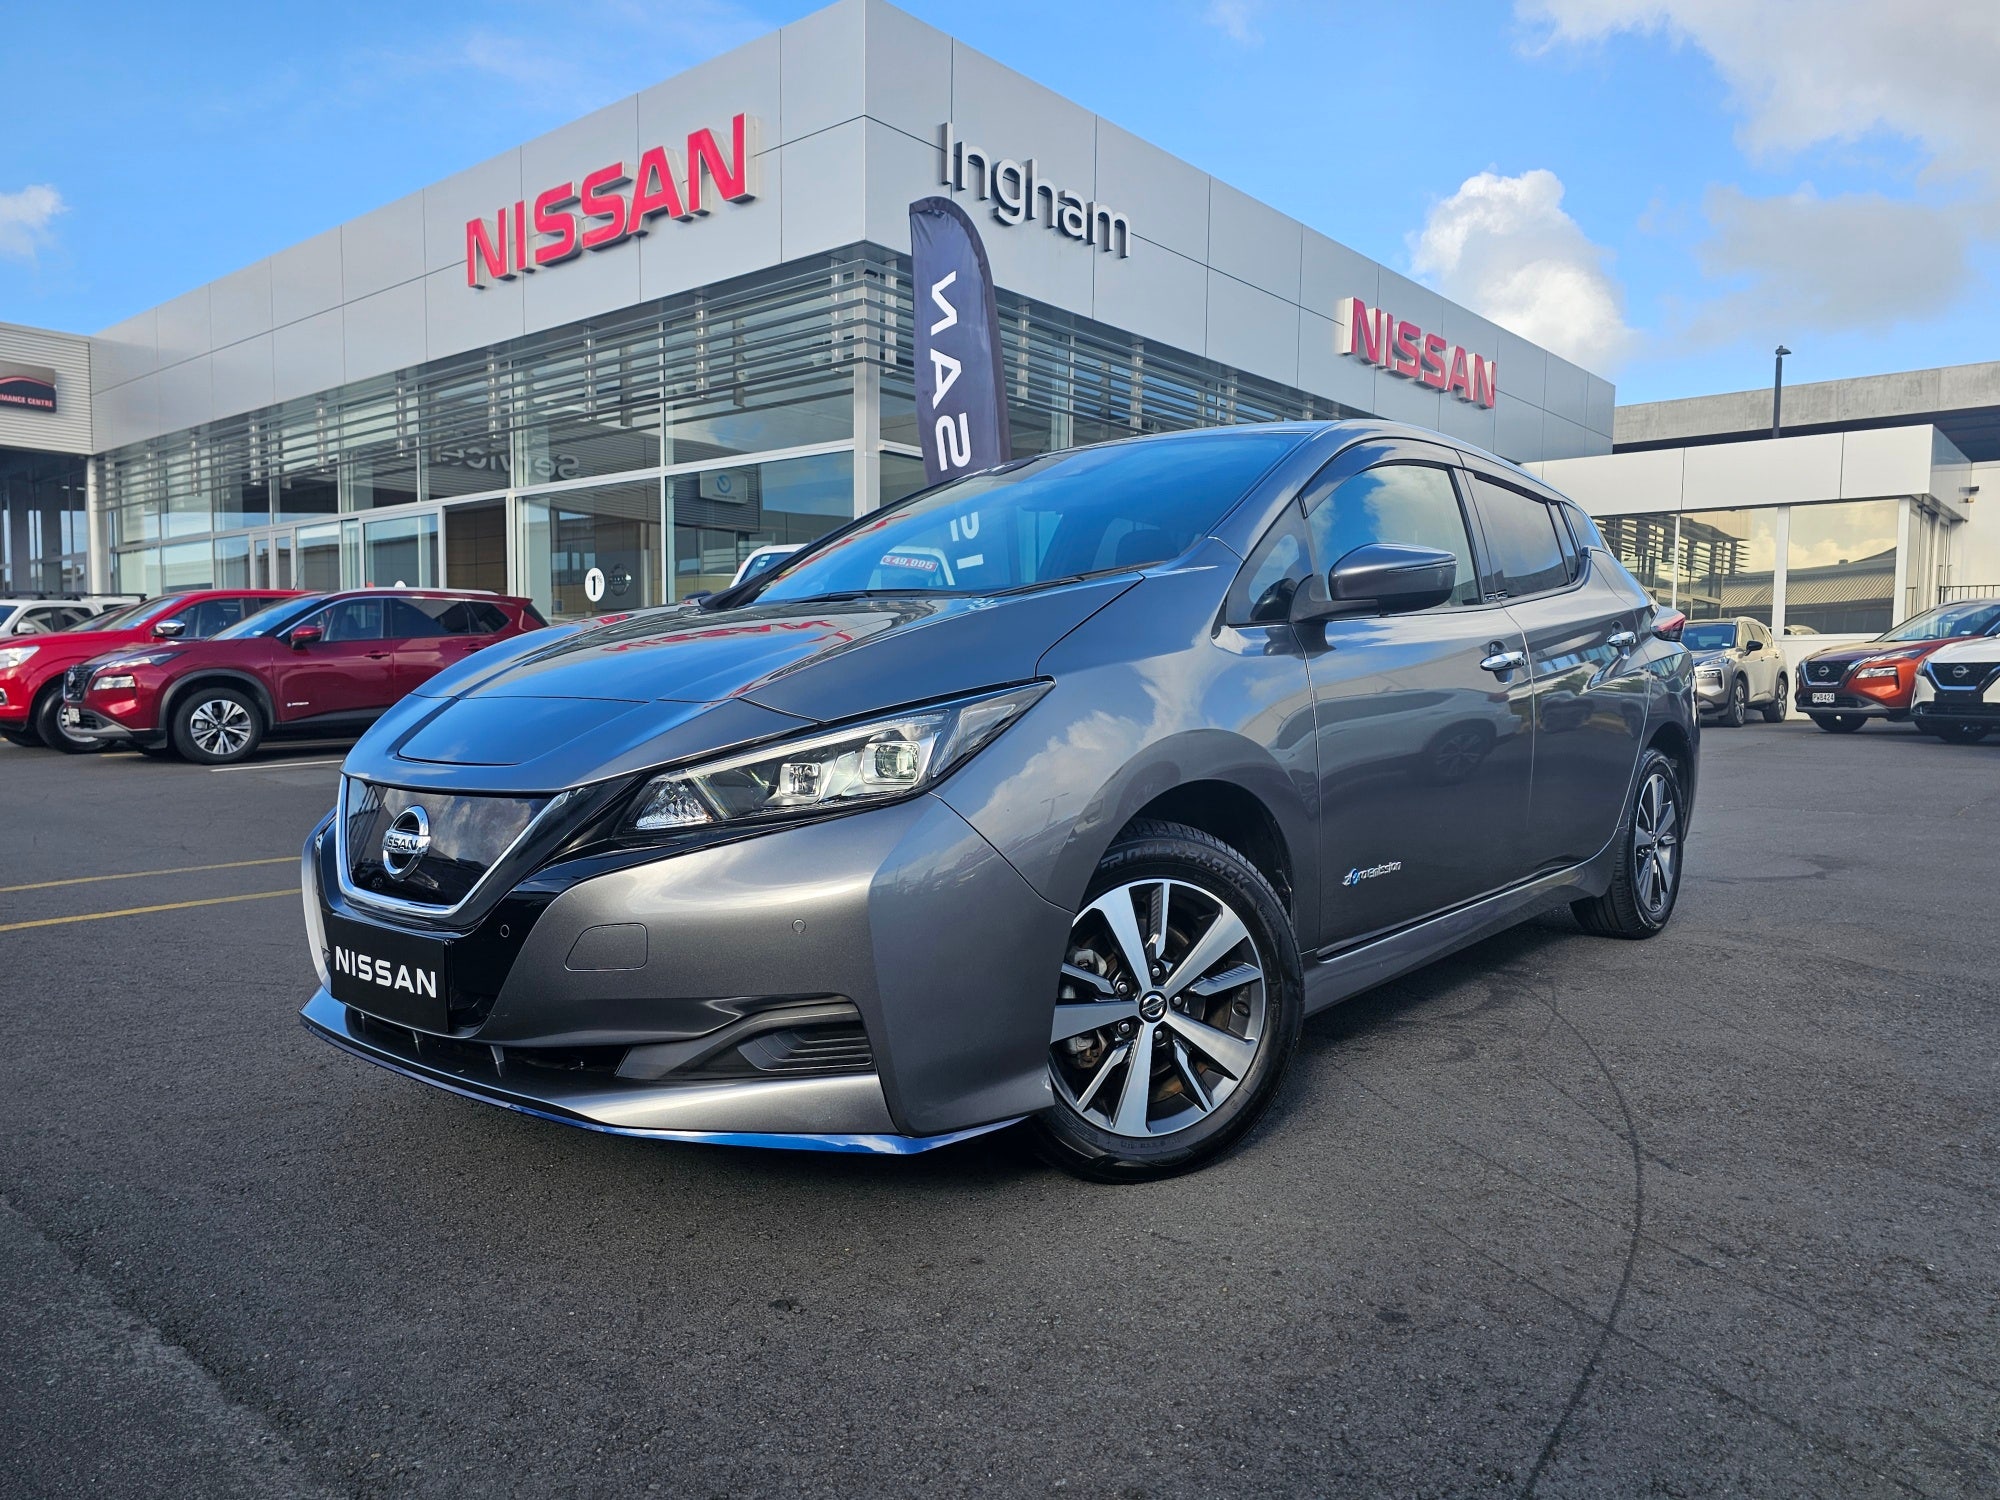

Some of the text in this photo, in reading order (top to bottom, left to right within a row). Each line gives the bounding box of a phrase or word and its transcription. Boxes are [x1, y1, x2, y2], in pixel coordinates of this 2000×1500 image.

[466, 112, 749, 288] NISSAN
[941, 122, 1131, 258] Ingham
[0, 393, 53, 407] MANCE CENTRE
[1347, 296, 1496, 409] NISSAN
[335, 945, 437, 999] NISSAN
